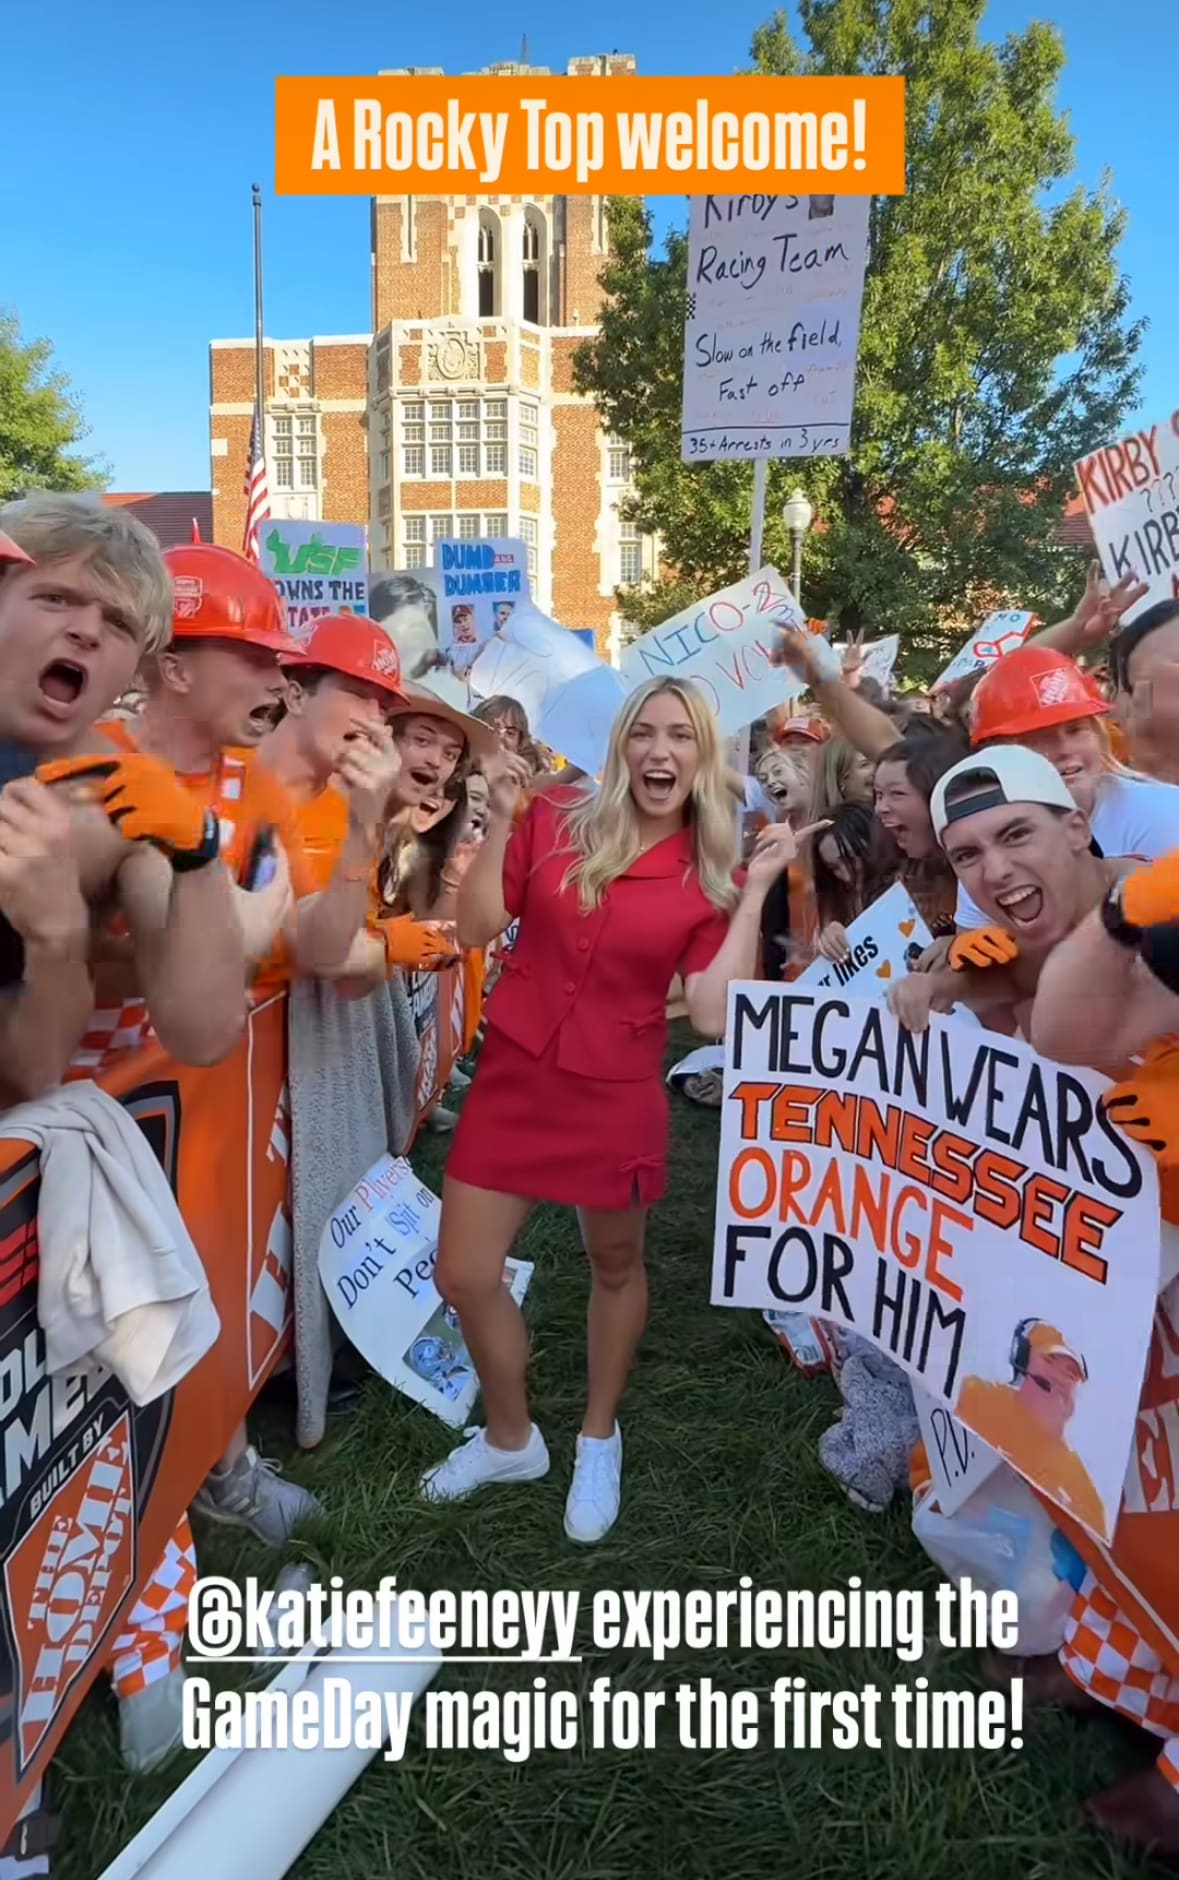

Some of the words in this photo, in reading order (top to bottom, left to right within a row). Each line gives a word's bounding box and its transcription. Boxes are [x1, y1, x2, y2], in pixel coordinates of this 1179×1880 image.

[697, 245, 767, 290] Racing
[773, 233, 849, 273] Team
[695, 332, 734, 368] Slow
[738, 345, 753, 359] on
[760, 331, 782, 356] the
[719, 377, 758, 401] Fast
[767, 371, 805, 397] off
[780, 437, 792, 449] in
[799, 428, 809, 449] 3
[812, 436, 840, 453] yrs
[1075, 425, 1160, 514] KIRBY
[1108, 508, 1179, 579] KIRB
[328, 580, 366, 601] THE
[732, 993, 931, 1109] MEGAN
[940, 1030, 1143, 1199] WEARS
[329, 1205, 362, 1250] Our
[728, 1081, 1125, 1286] TENNESSEE
[728, 1146, 975, 1304] ORANGE
[336, 1236, 397, 1311] Don't
[415, 1187, 435, 1209] on
[723, 1224, 856, 1323] FOR
[872, 1256, 967, 1400] HIM
[30, 1442, 80, 1520] BUILT
[82, 1411, 105, 1454] BY
[20, 1435, 127, 1724] HOME
